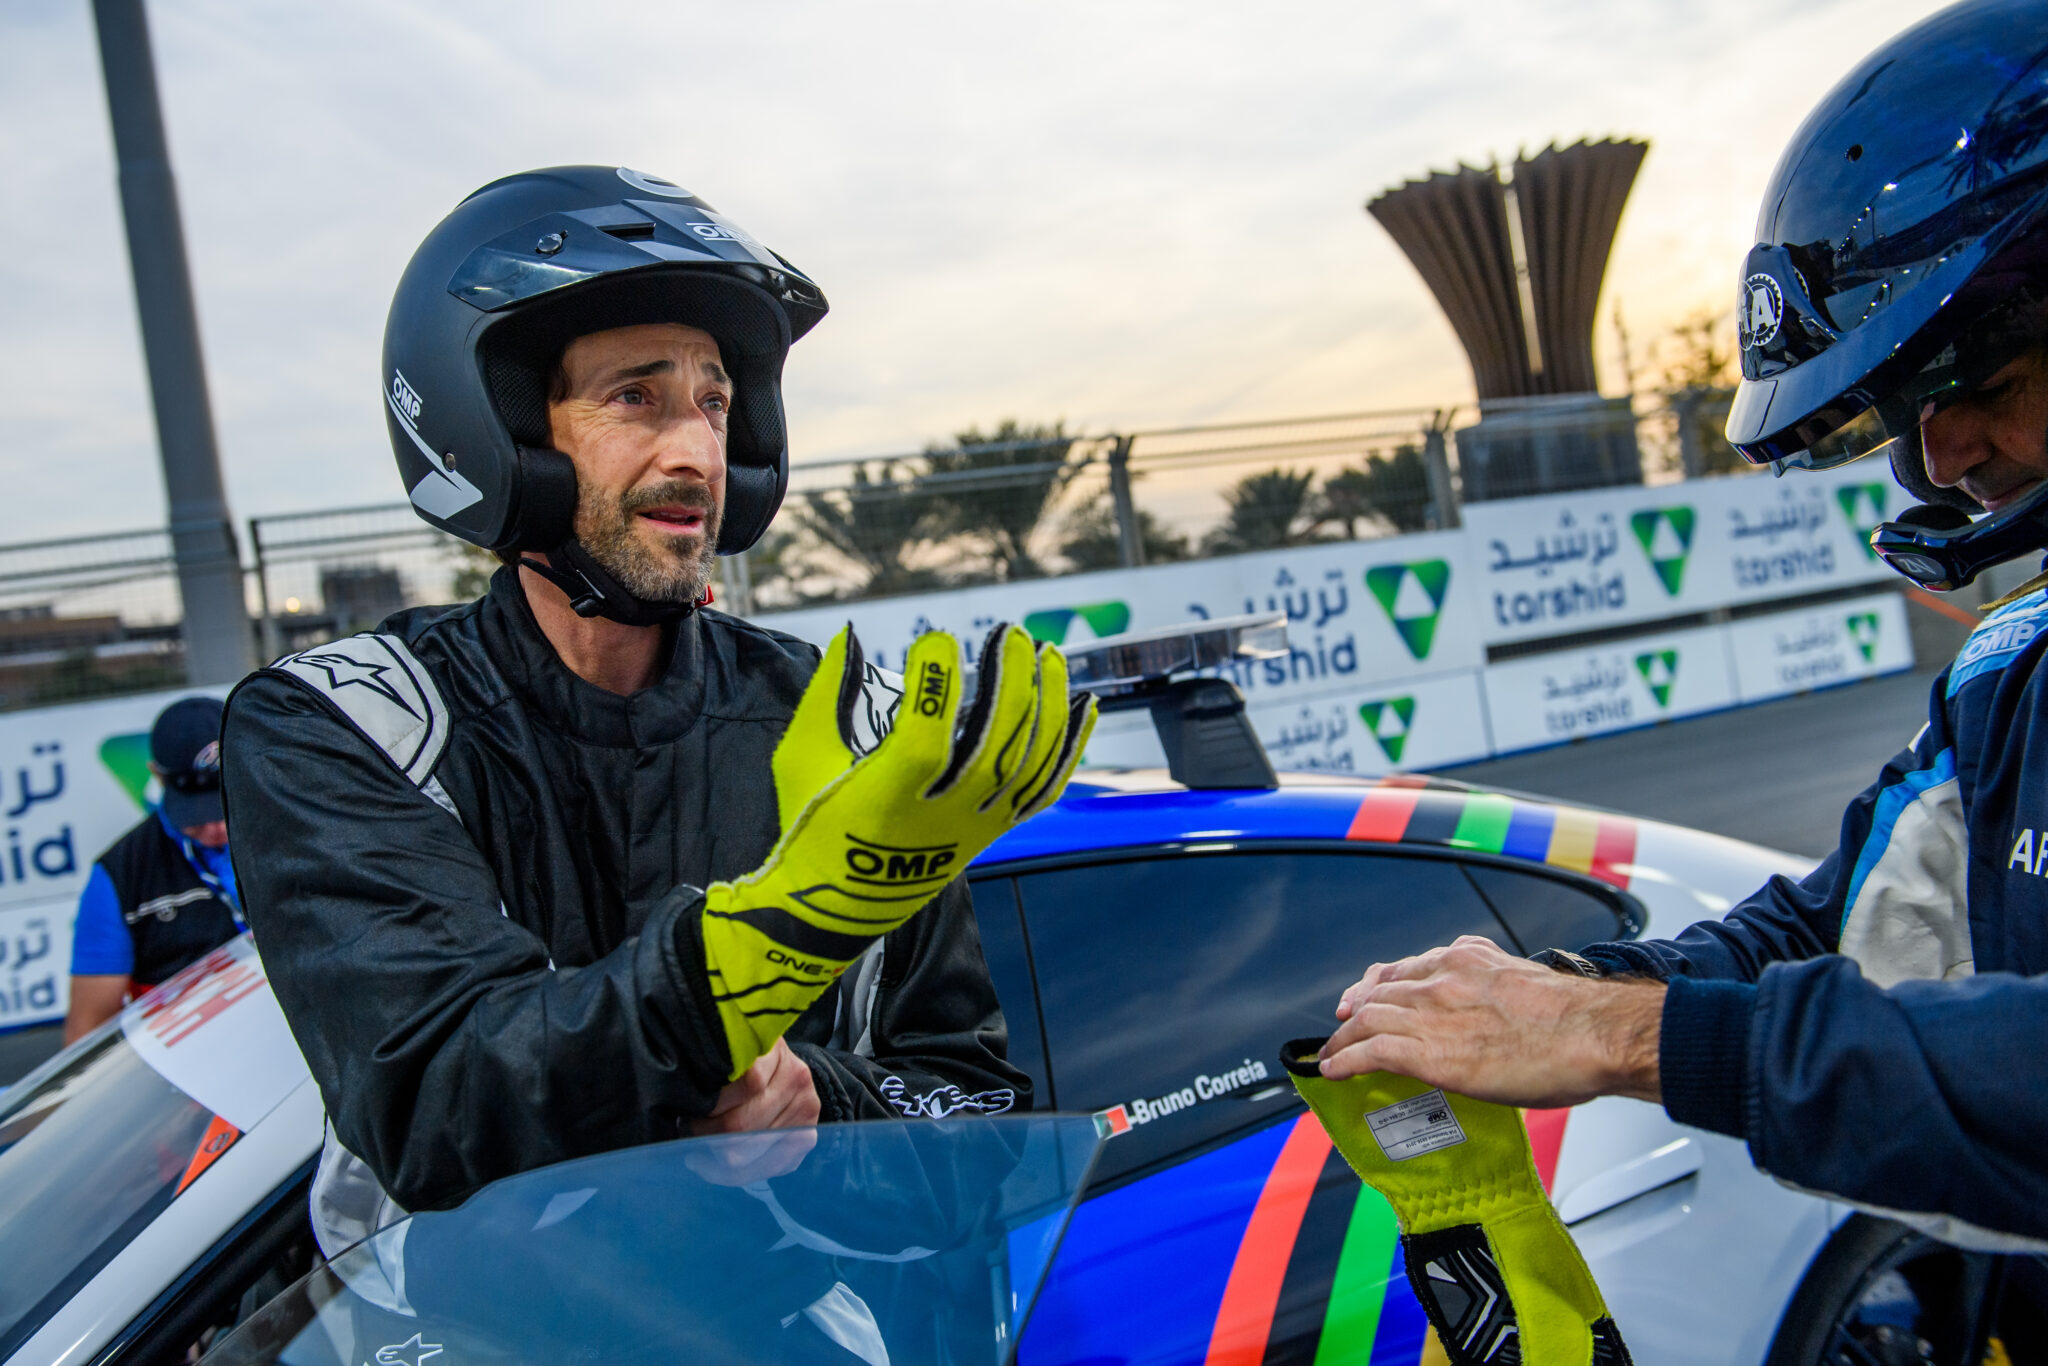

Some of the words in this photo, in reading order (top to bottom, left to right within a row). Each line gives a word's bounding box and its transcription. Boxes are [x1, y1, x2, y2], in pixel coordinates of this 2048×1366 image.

[393, 377, 421, 419] OMP
[1490, 509, 1619, 578] ترشيد
[1964, 622, 2036, 661] OMP
[920, 662, 945, 718] OMP
[845, 848, 955, 880] OMP
[1131, 1098, 1197, 1125] Bruno
[1194, 1058, 1268, 1101] Correia
[1427, 1110, 1448, 1123] OMP
